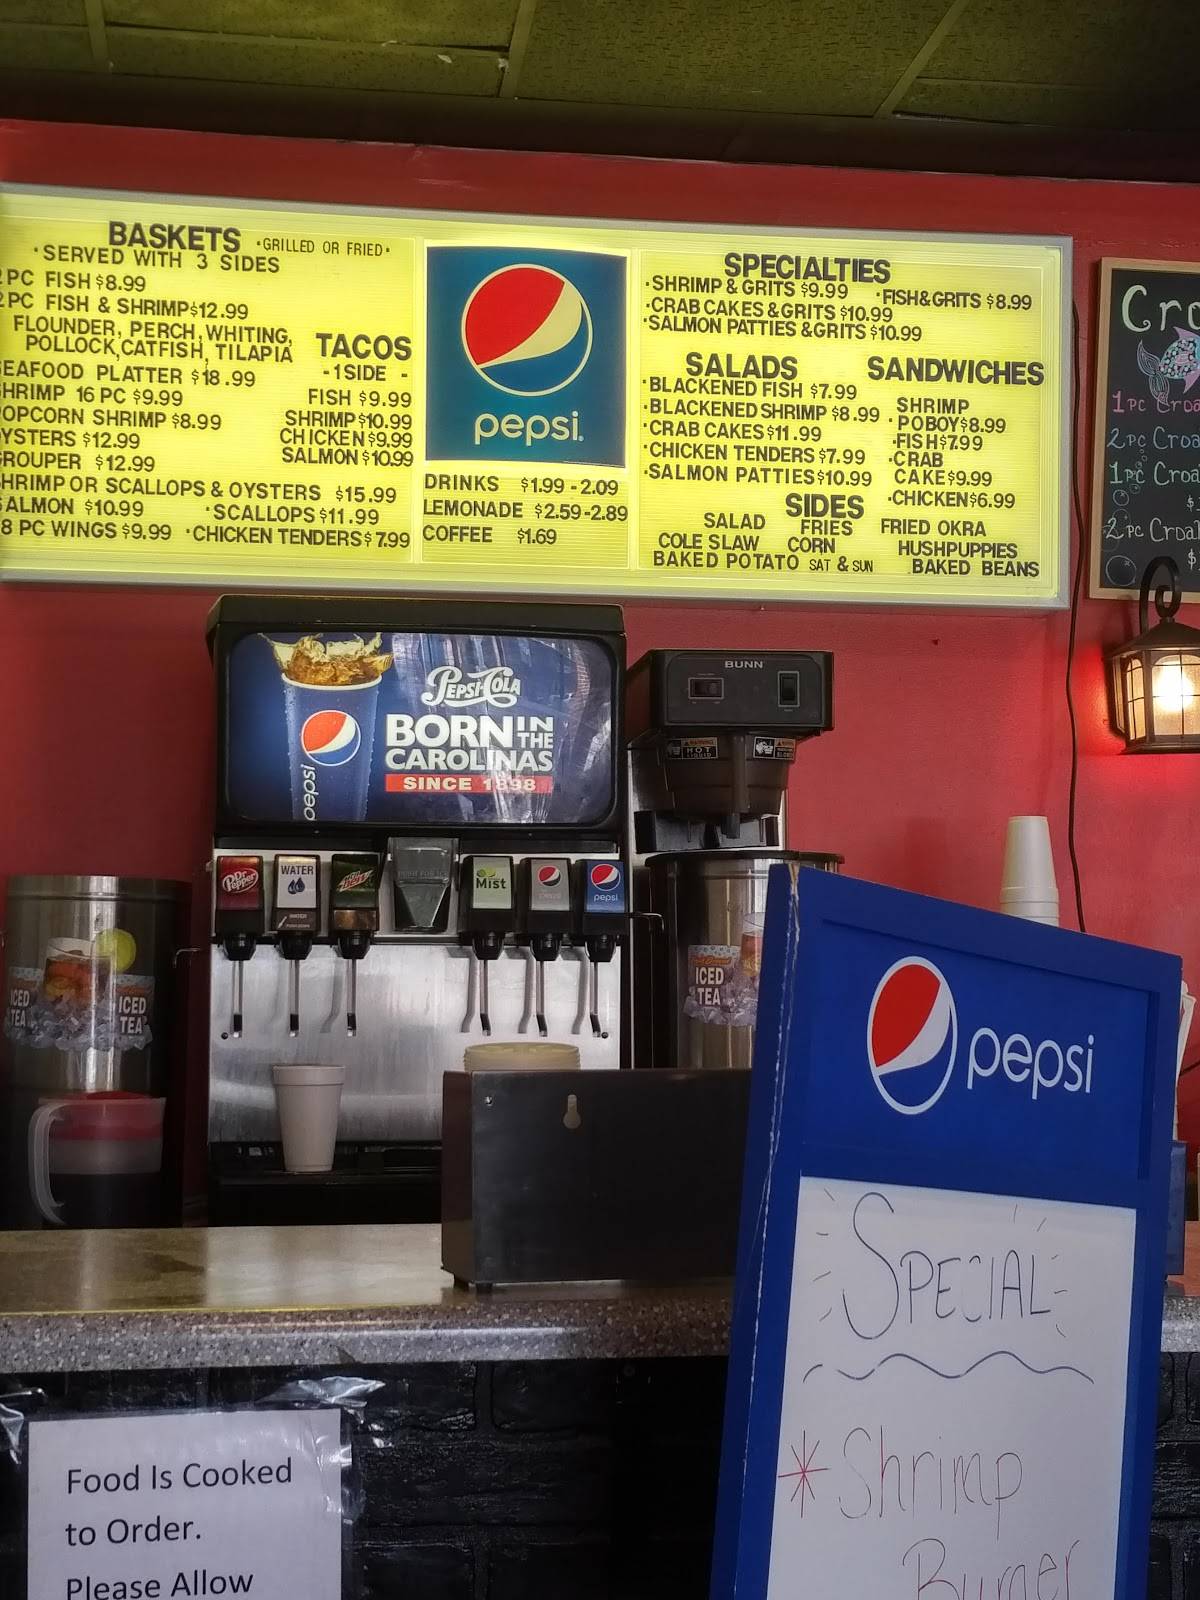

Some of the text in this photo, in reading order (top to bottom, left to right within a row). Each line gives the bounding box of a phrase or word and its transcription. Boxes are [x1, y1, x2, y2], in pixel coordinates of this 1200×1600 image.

[109, 221, 241, 253] BASKETS
[263, 238, 382, 256] GRILLED OR FRIED
[43, 245, 279, 273] SERVED WITH 3 SIDES
[724, 252, 891, 284] SPECIALTIES
[46, 271, 146, 292] FISH $8.99
[652, 275, 848, 298] SHRIMP & GRITS $9.99
[46, 295, 89, 312] FISH
[98, 296, 110, 313] &
[652, 297, 893, 323] CRAB CAKES $10.99
[987, 293, 1032, 310] $8.99
[14, 316, 121, 338] FLOUNDER,
[206, 325, 292, 346] WHITING,
[649, 315, 922, 341] SALMON PATTIES $10.99
[216, 344, 293, 362] TILAPIA
[316, 333, 412, 360] TACOS
[0, 360, 255, 387] EAFOOD PLATTER $18.99
[686, 352, 798, 380] SALADS
[868, 356, 1044, 385] SANDWICHES
[0, 383, 183, 406] HRIMP 16 PC $9.99
[309, 389, 411, 408] FISH $9.99
[650, 377, 857, 400] BLACKENED FISH $7.99
[650, 398, 880, 422] BLACKENED SHRIMP $8.99
[897, 397, 969, 415] SHRIMP
[0, 406, 222, 430] OPCORN SHRIMP $8.99
[285, 410, 412, 429] SHRIMP $10.99
[474, 410, 579, 446] pepsi
[0, 428, 140, 449] YSTERS $12.99
[280, 428, 412, 448] CHICKEN $9.99
[650, 420, 822, 442] CRAB CAKES $11.99
[0, 451, 155, 472] ROUPER $12.99
[282, 447, 413, 467] SALMON $10.99
[650, 442, 865, 465] CHICKEN TENDERS $7.99
[893, 451, 943, 468] CRAB
[425, 474, 499, 491] DRINKS
[521, 477, 564, 493] $1.99
[649, 463, 872, 487] SALMON PATTIES $10.99
[0, 474, 396, 503] HRIMP OR SCALLOPS & OYSTERS $15.99
[0, 496, 143, 517] ALMON $10.99
[213, 504, 379, 525] SCALLOPS $11.99
[423, 499, 523, 518] LEMONADE
[785, 493, 864, 519] SIDES
[1, 519, 171, 540] 8 PC WINGS $9.99
[704, 513, 765, 530] SALAD
[801, 519, 853, 536] FRIES
[881, 518, 986, 537] FRIED OKRA
[193, 525, 273, 544] CHICKEN
[278, 528, 362, 546] TENDERS
[423, 525, 557, 545] COFFEE $1.69
[658, 533, 759, 551] COLE SLAW
[788, 537, 835, 554] CORN
[899, 540, 1018, 559] HUSHPUPPIES
[653, 551, 873, 572] BAKED POTATO SAT & SUN
[912, 559, 1039, 577] BAKED BEANS
[386, 715, 554, 749] BORN IN THE
[385, 749, 553, 771] CAROLINAS
[403, 777, 472, 790] SINCE
[281, 865, 313, 875] WATER
[476, 878, 506, 888] Mist
[695, 966, 724, 985] ICED
[11, 990, 29, 1007] ICED
[119, 996, 146, 1014] ICED
[697, 987, 720, 1005] TEA
[11, 1010, 25, 1026] TEA
[120, 1016, 142, 1033] TEA
[967, 1027, 1094, 1100] pepsi
[843, 1192, 1050, 1339] SPECIAL
[68, 1458, 292, 1494] Food Is Cooked
[66, 1516, 201, 1546] to Order.
[67, 1570, 253, 1600] Please Allow
